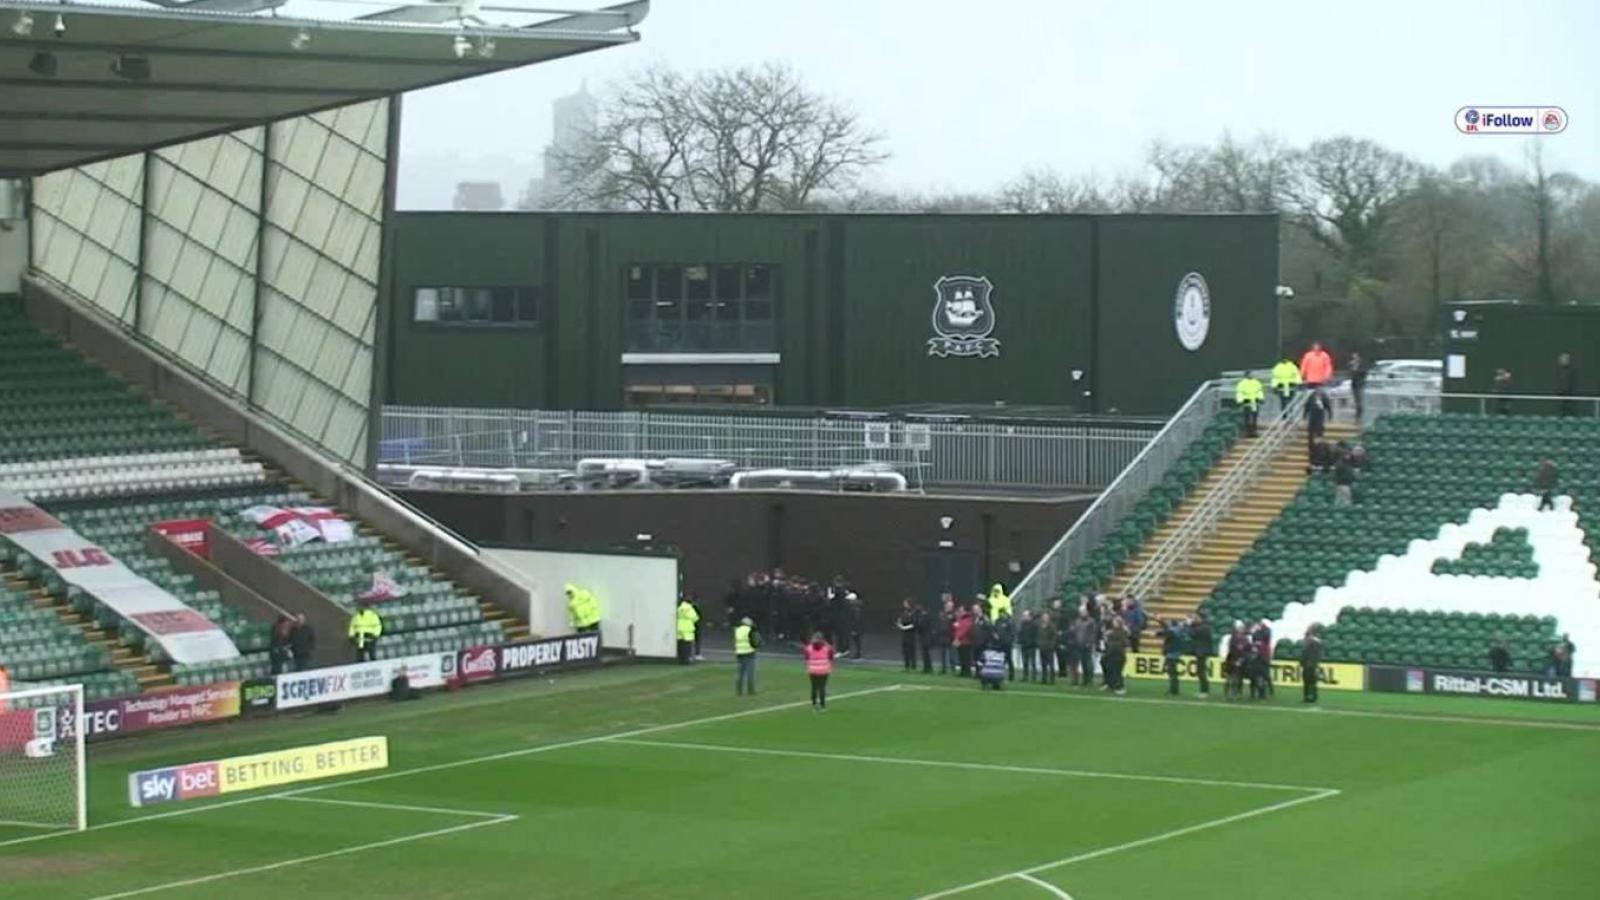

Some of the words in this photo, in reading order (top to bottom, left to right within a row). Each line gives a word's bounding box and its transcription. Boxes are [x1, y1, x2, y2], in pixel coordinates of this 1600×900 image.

[502, 641, 563, 670] PROPERLY
[564, 635, 599, 661] TASTY
[281, 671, 348, 701] SCREWFIX
[1433, 674, 1528, 697] Rittal-CSM
[1532, 680, 1568, 699] Ltd.
[141, 775, 176, 800] sky
[181, 767, 217, 791] bet
[226, 756, 304, 785] BETTING
[315, 743, 381, 770] BETTER
